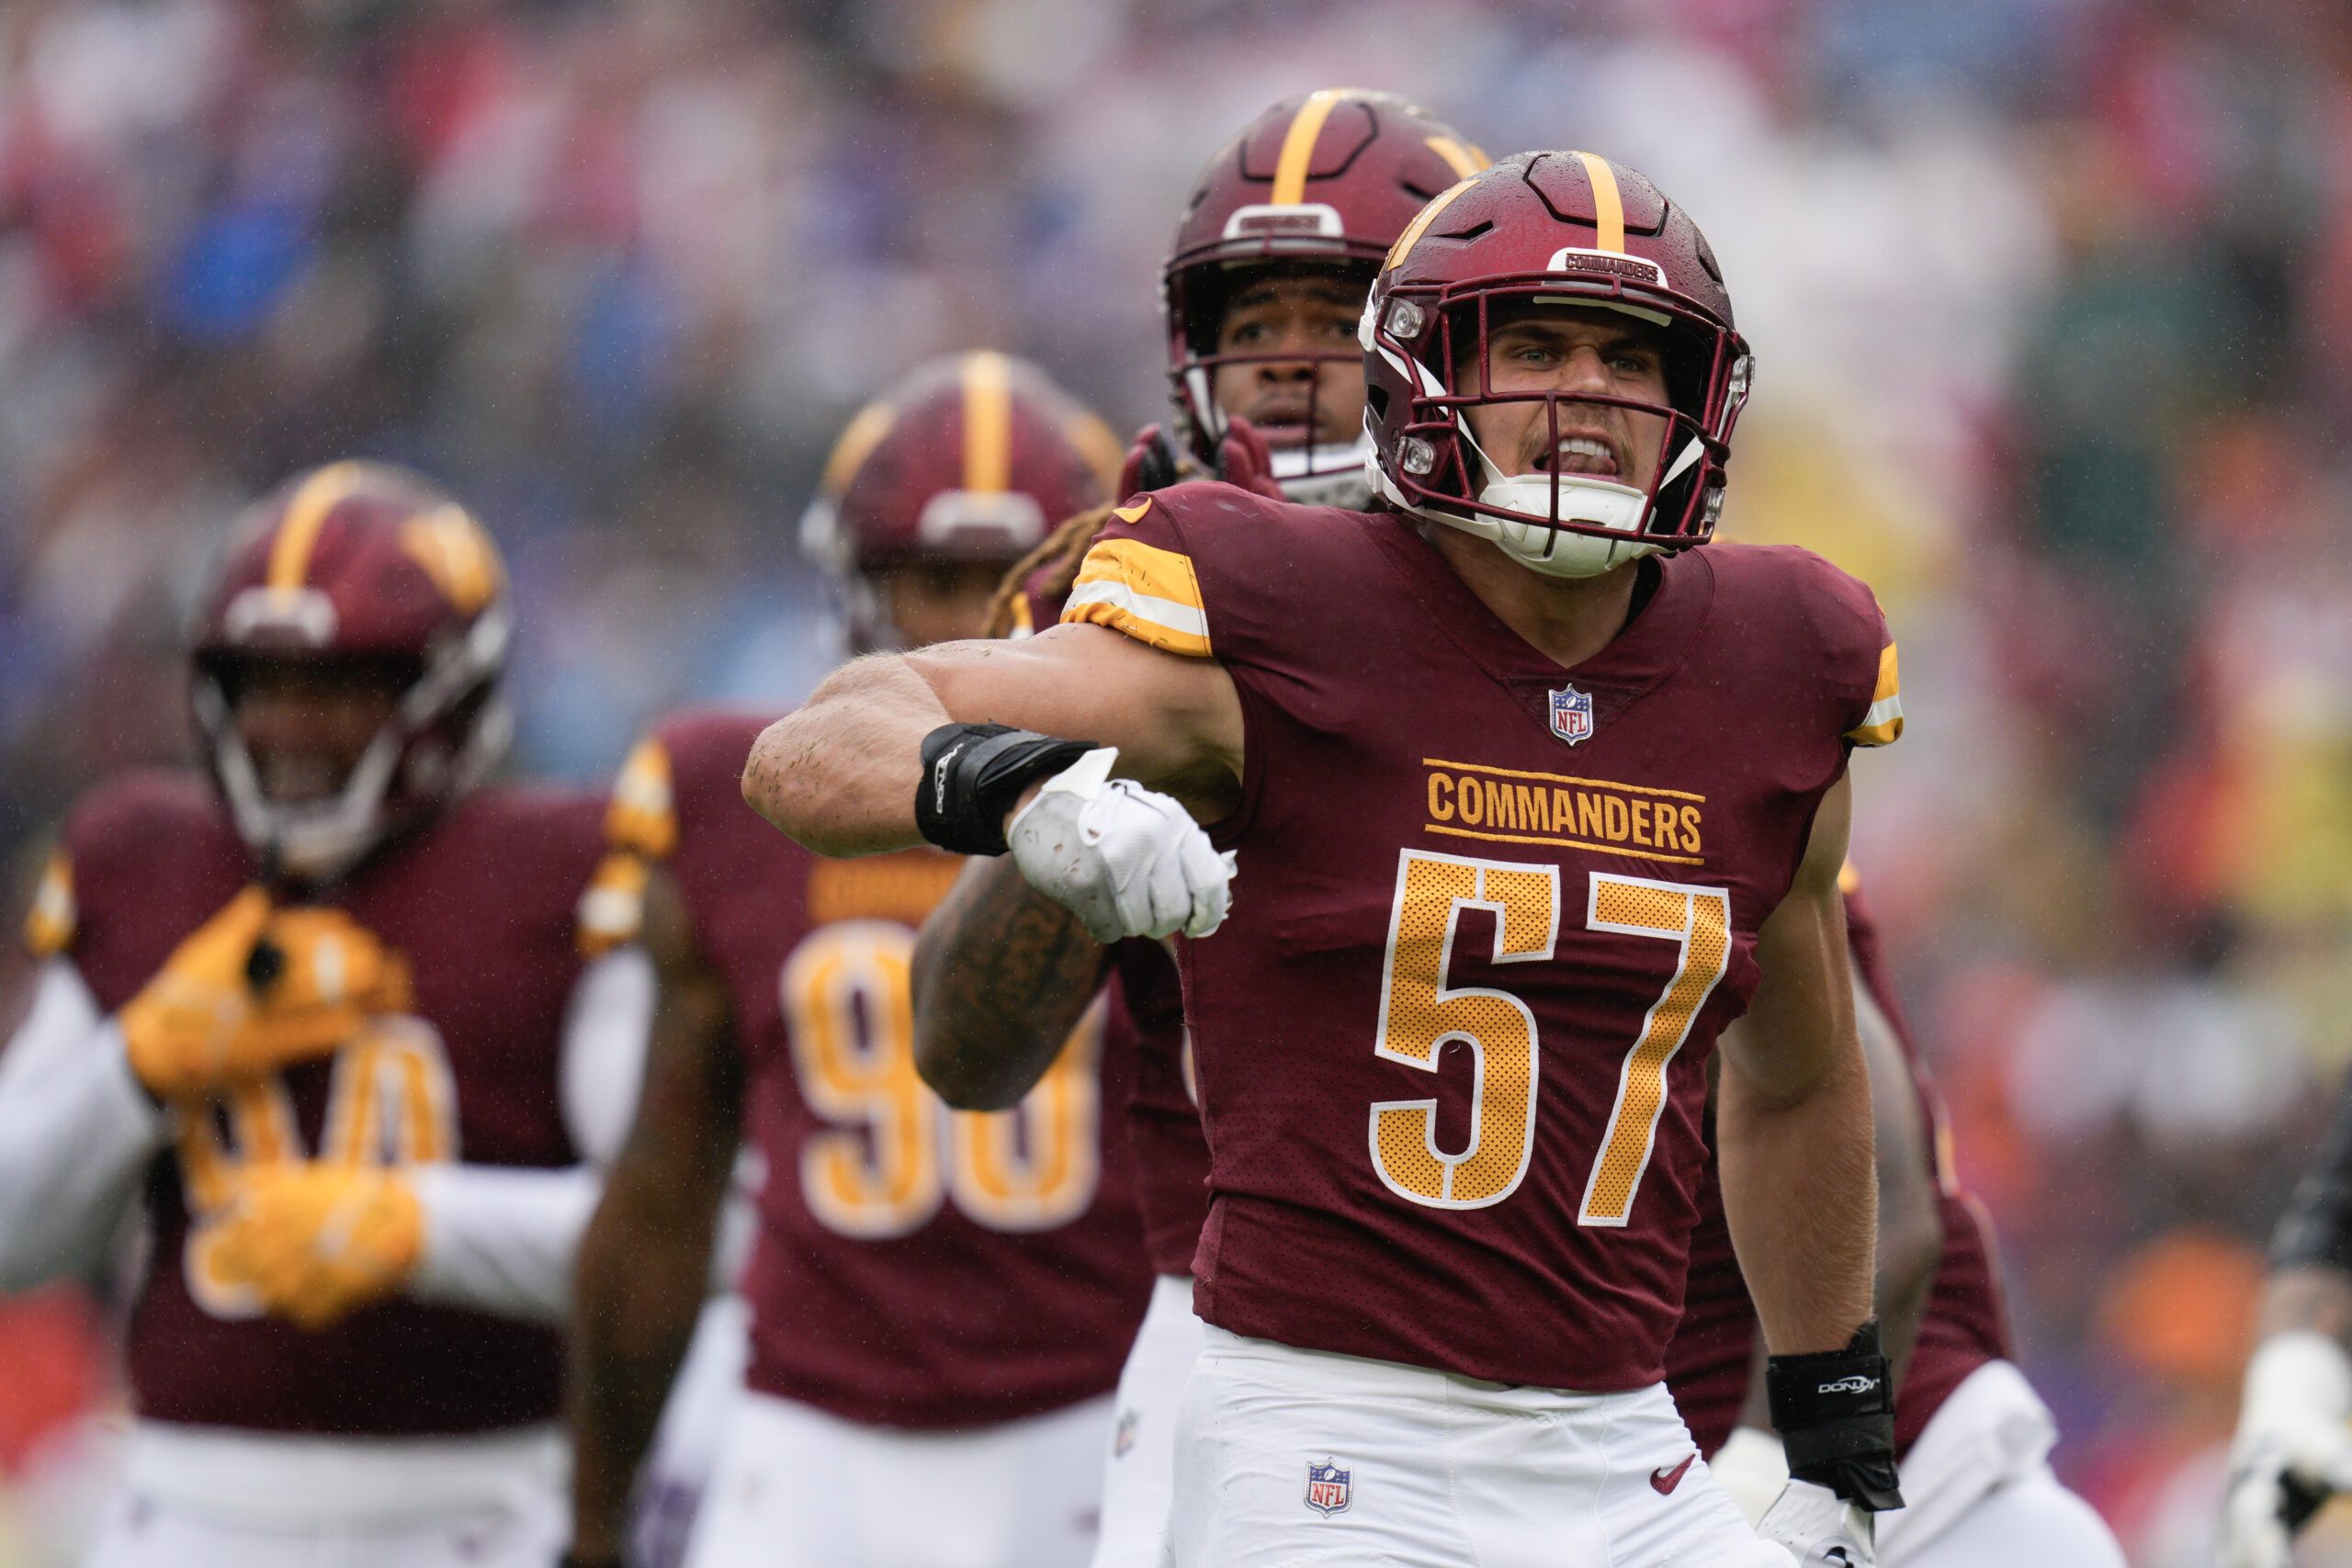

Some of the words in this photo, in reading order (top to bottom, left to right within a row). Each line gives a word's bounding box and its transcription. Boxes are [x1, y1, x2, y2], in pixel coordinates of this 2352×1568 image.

[1566, 255, 1658, 282] COMMANDERS
[1557, 711, 1587, 735] NFL
[1427, 772, 1702, 853] COMMANDERS
[1369, 848, 1733, 1227] 57
[1311, 1483, 1344, 1506] NFL
